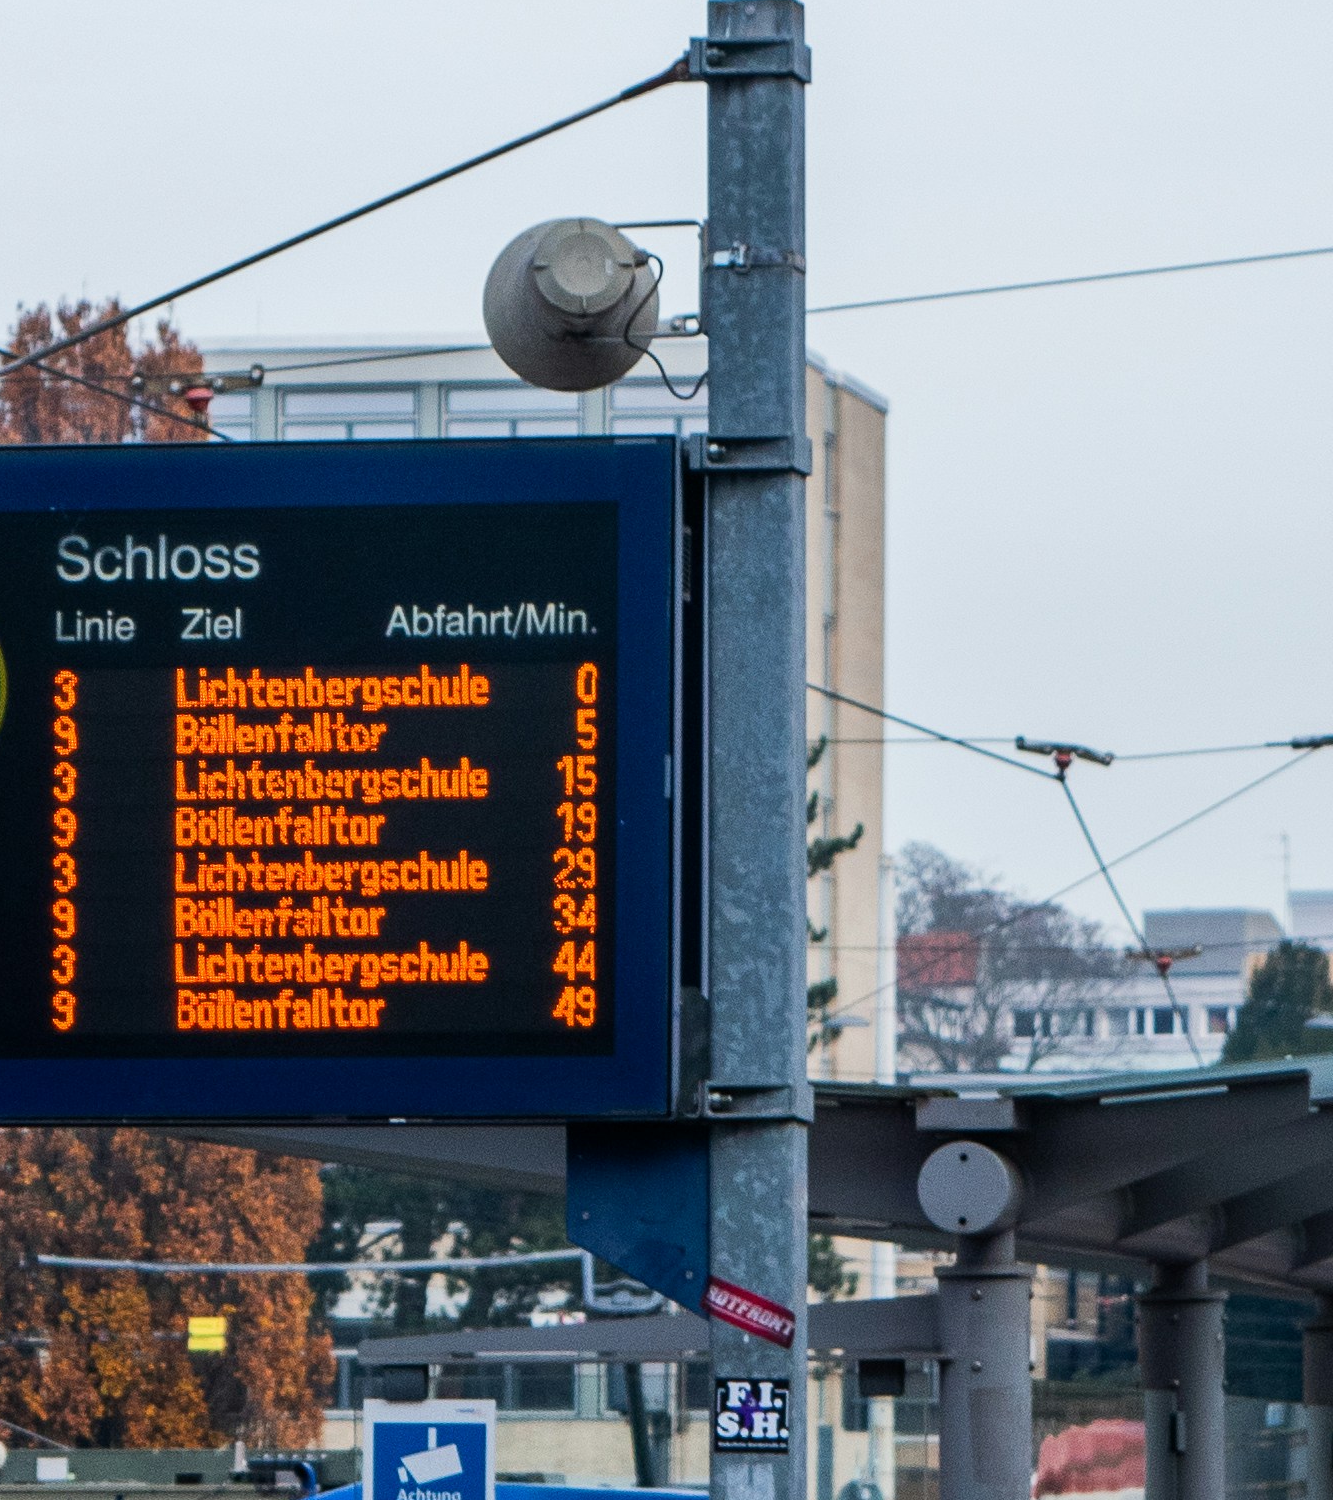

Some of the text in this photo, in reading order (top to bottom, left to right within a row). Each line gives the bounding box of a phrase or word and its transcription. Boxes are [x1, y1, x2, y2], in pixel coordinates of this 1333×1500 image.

[55, 534, 261, 582] Schloss
[55, 601, 597, 641] Linie Ziel Abfahrt/Min.
[53, 662, 598, 712] 3 Lichtenbergschule 0
[53, 708, 598, 756] 9 Böllenfalltor 5
[52, 754, 598, 804] 3 Lichtenbergschule 15
[52, 801, 597, 849] 9 Böllenfalltor 19
[52, 846, 597, 897] 3 Lichtenbergschule 29
[52, 897, 76, 940] 9
[174, 895, 387, 939] Böllenfalltor
[51, 940, 596, 988] 3 Lichtenbergschule 44
[52, 985, 597, 1031] 9 Böllenfalltor 49
